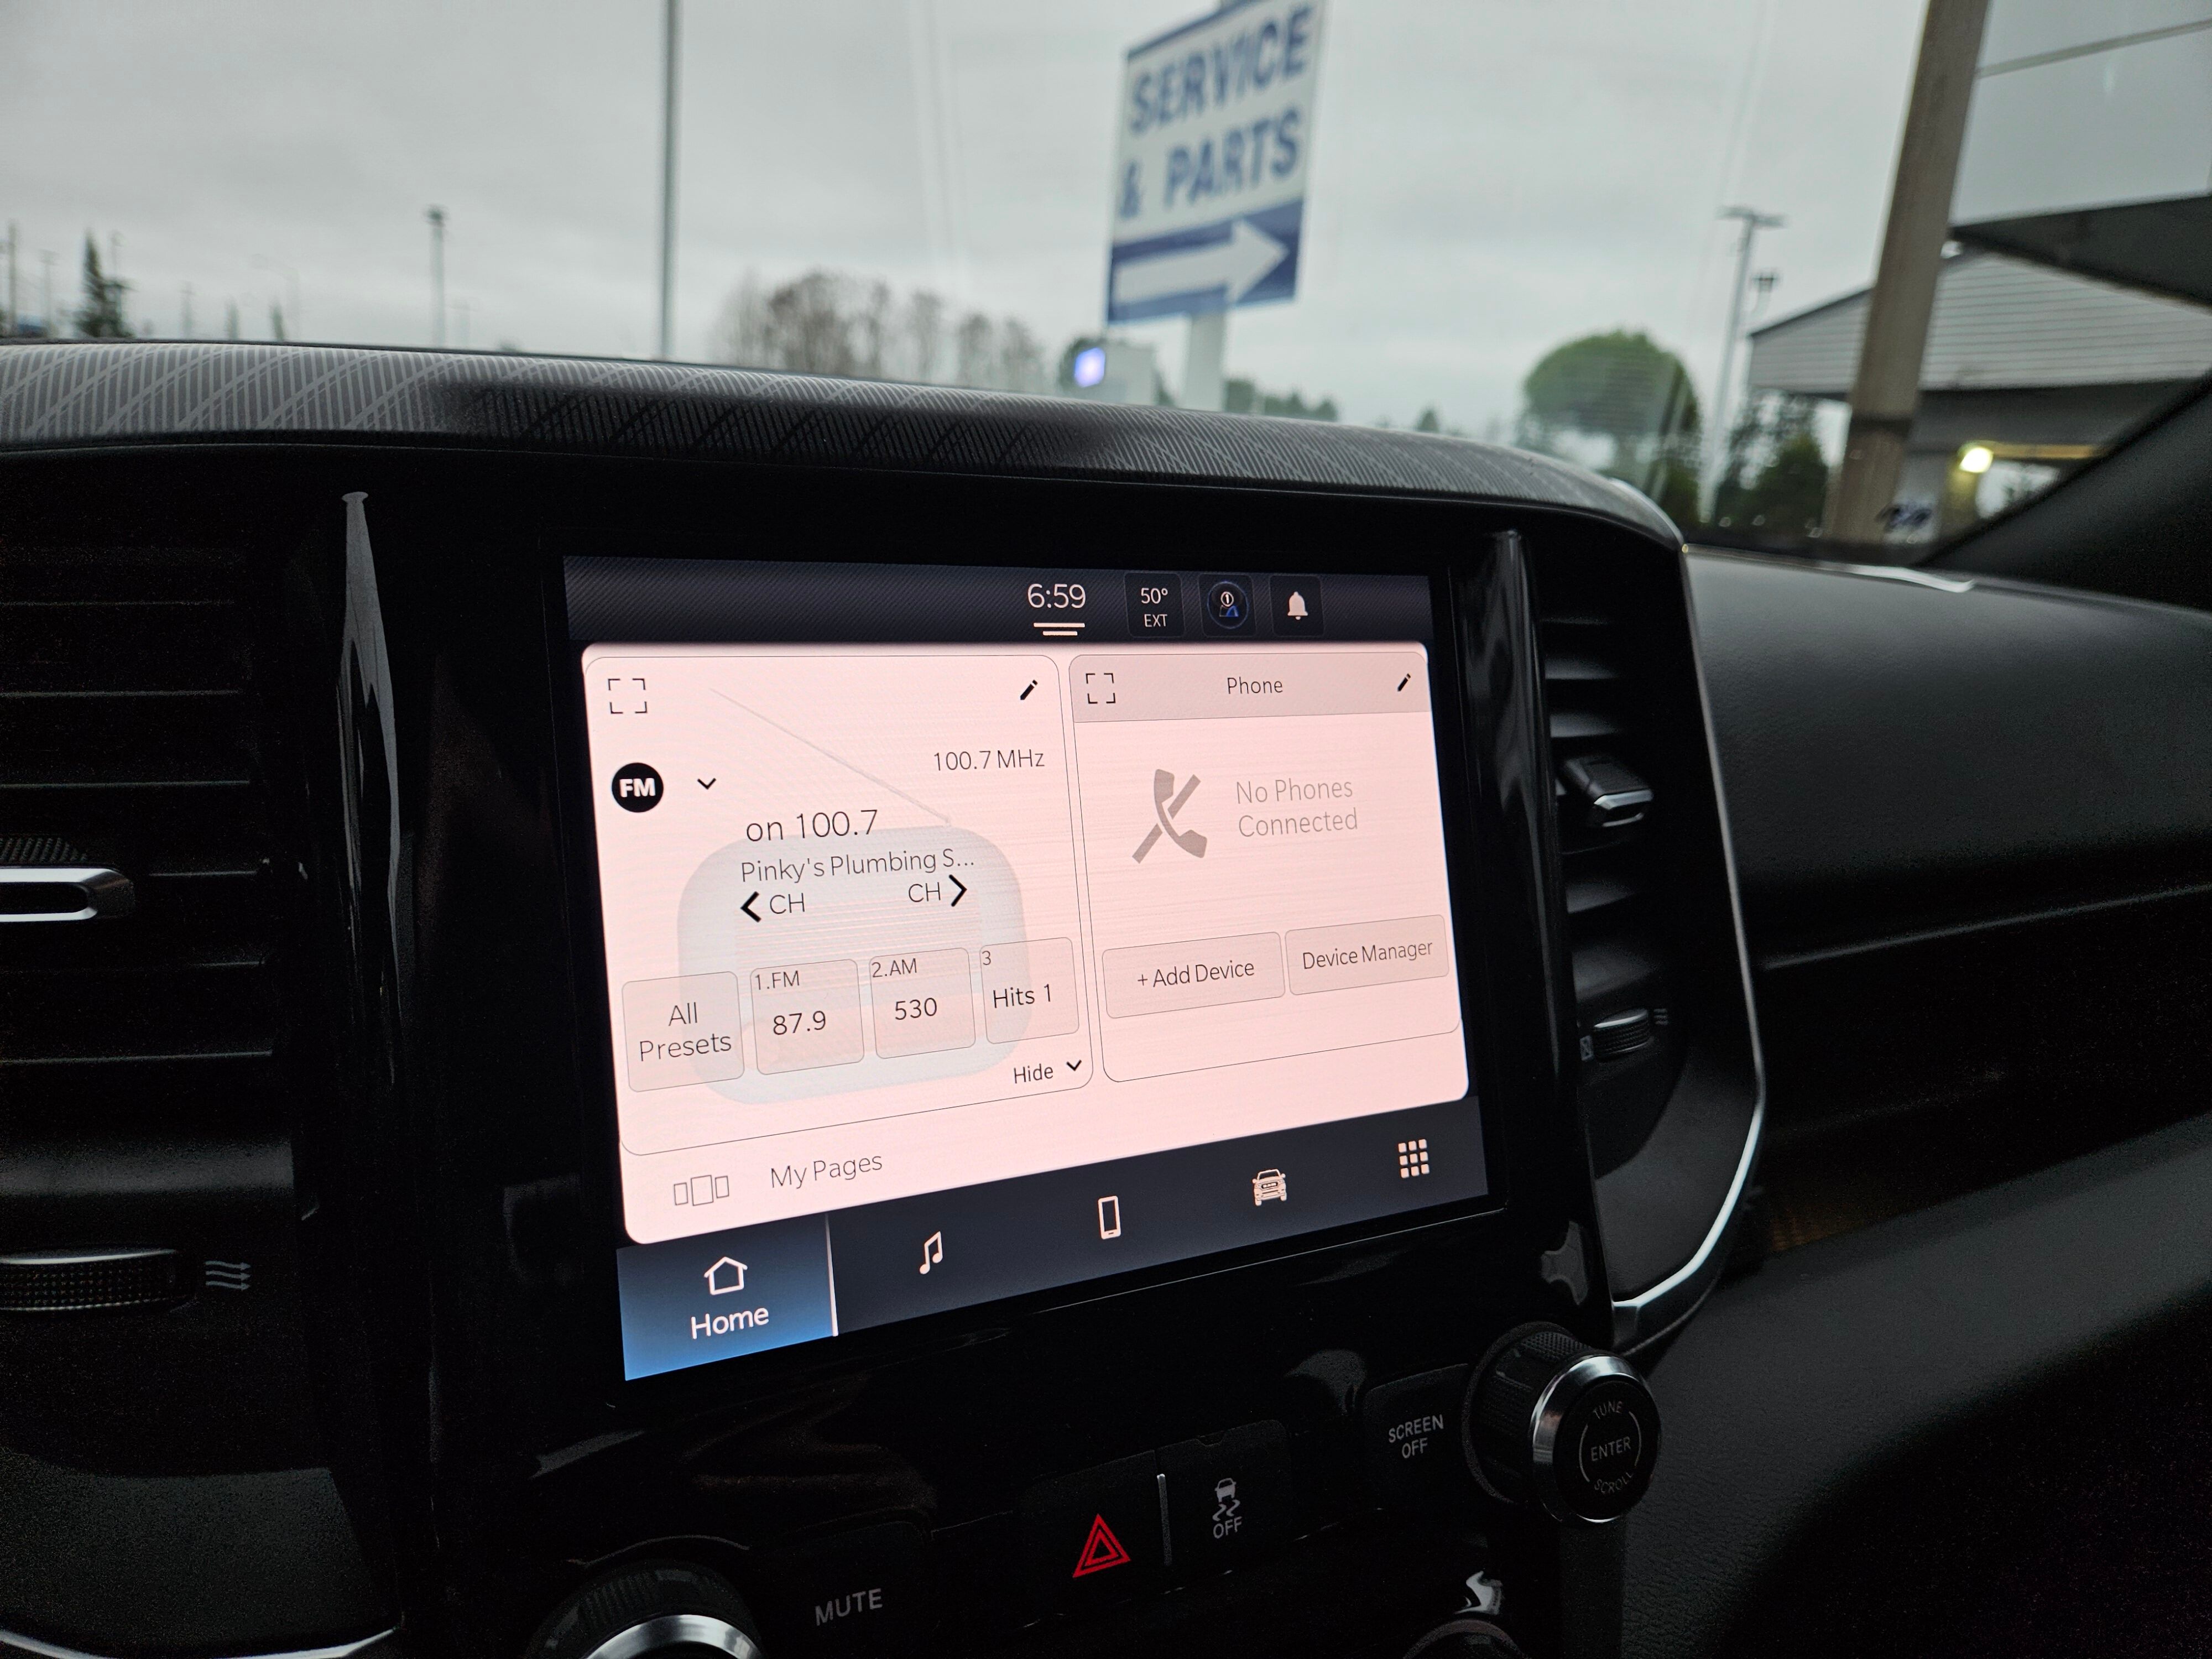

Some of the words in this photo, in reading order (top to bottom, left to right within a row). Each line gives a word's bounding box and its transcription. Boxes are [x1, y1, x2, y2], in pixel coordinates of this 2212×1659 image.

[1128, 3, 1313, 135] SERVICE
[1164, 107, 1300, 208] PARTS
[1027, 583, 1086, 609] 6:59
[1144, 614, 1167, 628] EXT
[1227, 676, 1284, 695] Phone
[933, 750, 992, 771] 100.7
[997, 749, 1045, 768] MHz
[619, 778, 656, 798] FM
[1236, 780, 1268, 804] No
[1275, 778, 1353, 802] Phones
[746, 821, 784, 842] on
[796, 809, 878, 839] 100.7
[1238, 807, 1358, 837] Connected
[742, 858, 825, 884] Pinky's
[830, 851, 936, 876] Plumbing
[769, 893, 805, 915] CH
[908, 881, 941, 903] CH
[982, 951, 992, 966] 3
[1302, 943, 1358, 970] Device
[1361, 941, 1433, 963] Manager
[1152, 963, 1191, 988] Add
[1194, 959, 1255, 983] Device
[894, 997, 938, 1020] 530
[993, 987, 1035, 1009] Hits
[1044, 983, 1052, 1002] 1
[668, 1001, 698, 1026] All
[773, 1010, 826, 1036] 87.9
[639, 1033, 732, 1062] Presets
[1013, 1063, 1054, 1084] Hide
[770, 1165, 807, 1190] My
[813, 1155, 883, 1181] Pages
[691, 1307, 769, 1340] Home
[1593, 1401, 1624, 1420] TUNE
[1388, 1413, 1444, 1444] SCREEN
[1401, 1438, 1429, 1459] OFF
[1590, 1436, 1631, 1462] ENTER
[1594, 1472, 1634, 1494] SCROLL
[1213, 1516, 1243, 1540] OFF
[815, 1588, 883, 1626] MUTE
